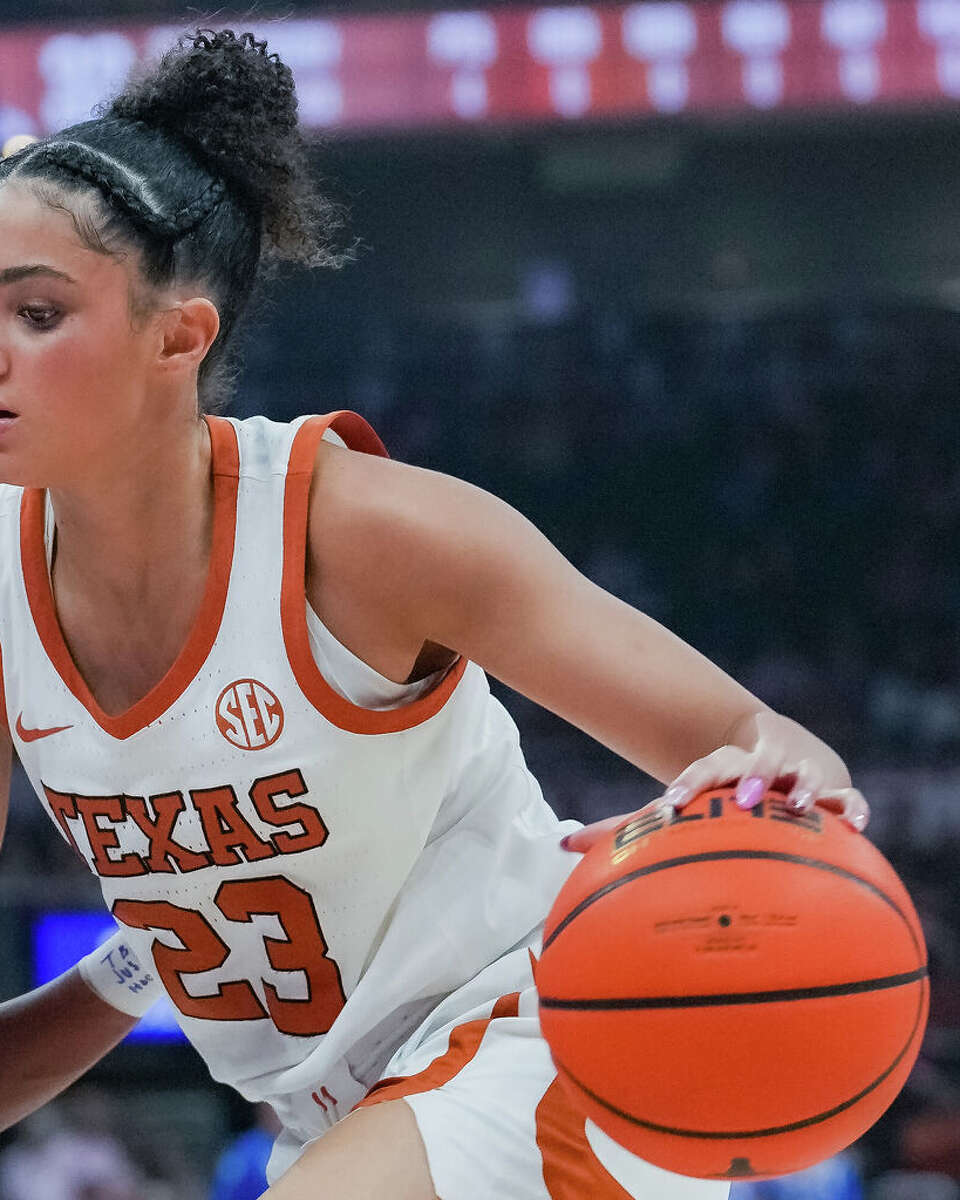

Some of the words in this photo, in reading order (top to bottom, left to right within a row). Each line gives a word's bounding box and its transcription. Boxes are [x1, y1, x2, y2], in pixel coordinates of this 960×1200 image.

[218, 681, 281, 748] SEC
[41, 768, 330, 877] TEXAS
[111, 875, 348, 1037] 23
